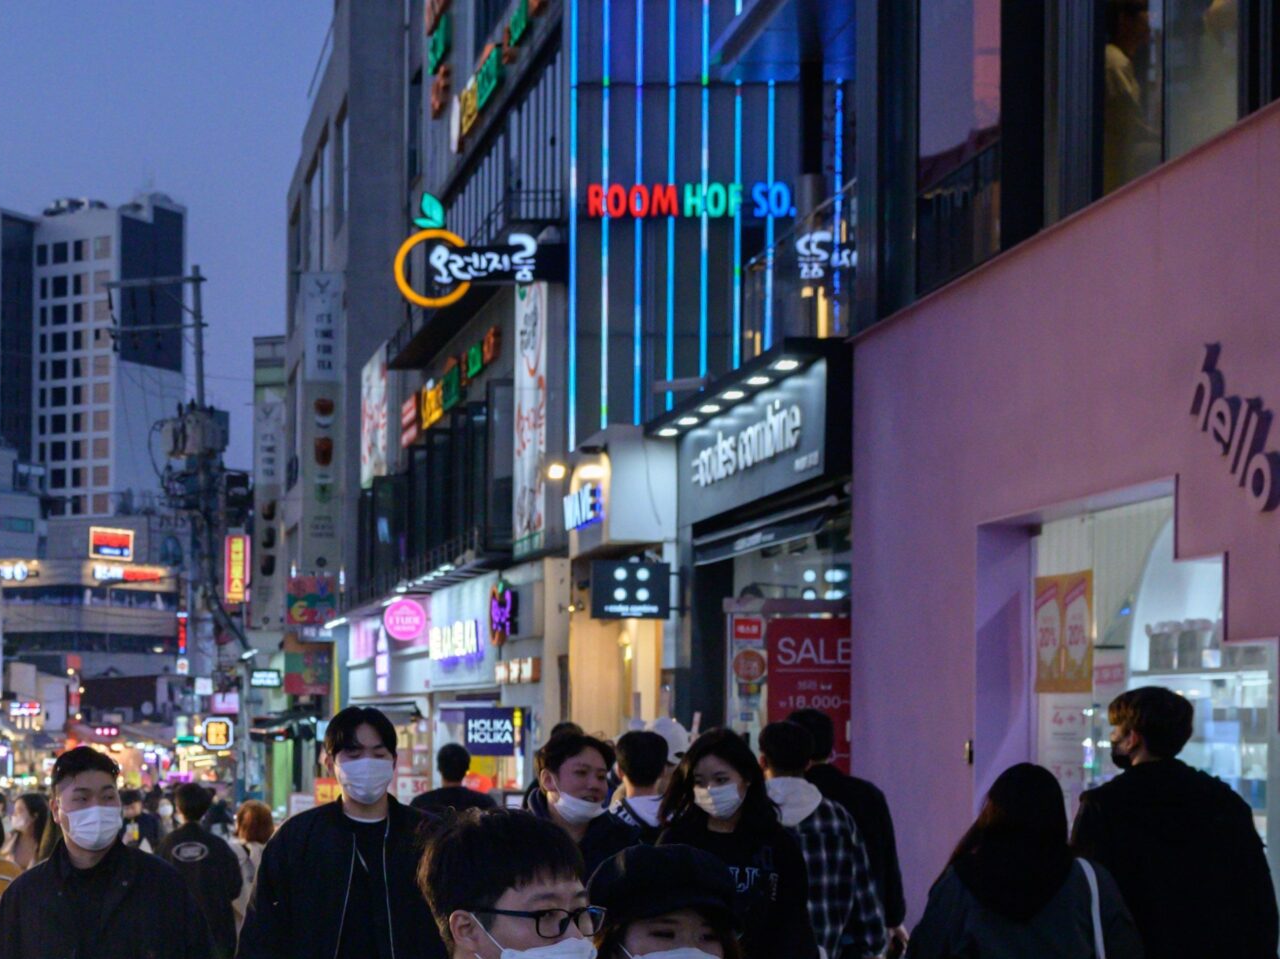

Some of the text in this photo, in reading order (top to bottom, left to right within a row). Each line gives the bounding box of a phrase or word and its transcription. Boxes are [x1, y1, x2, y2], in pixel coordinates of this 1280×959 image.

[588, 183, 679, 217] ROOM
[684, 182, 742, 217] HOF
[429, 233, 537, 283] 오렌지룸
[738, 399, 802, 471] combine
[1190, 342, 1280, 513] hello
[777, 637, 852, 666] SALE
[468, 719, 513, 731] HOLIKA
[468, 731, 513, 743] HOLIKA
